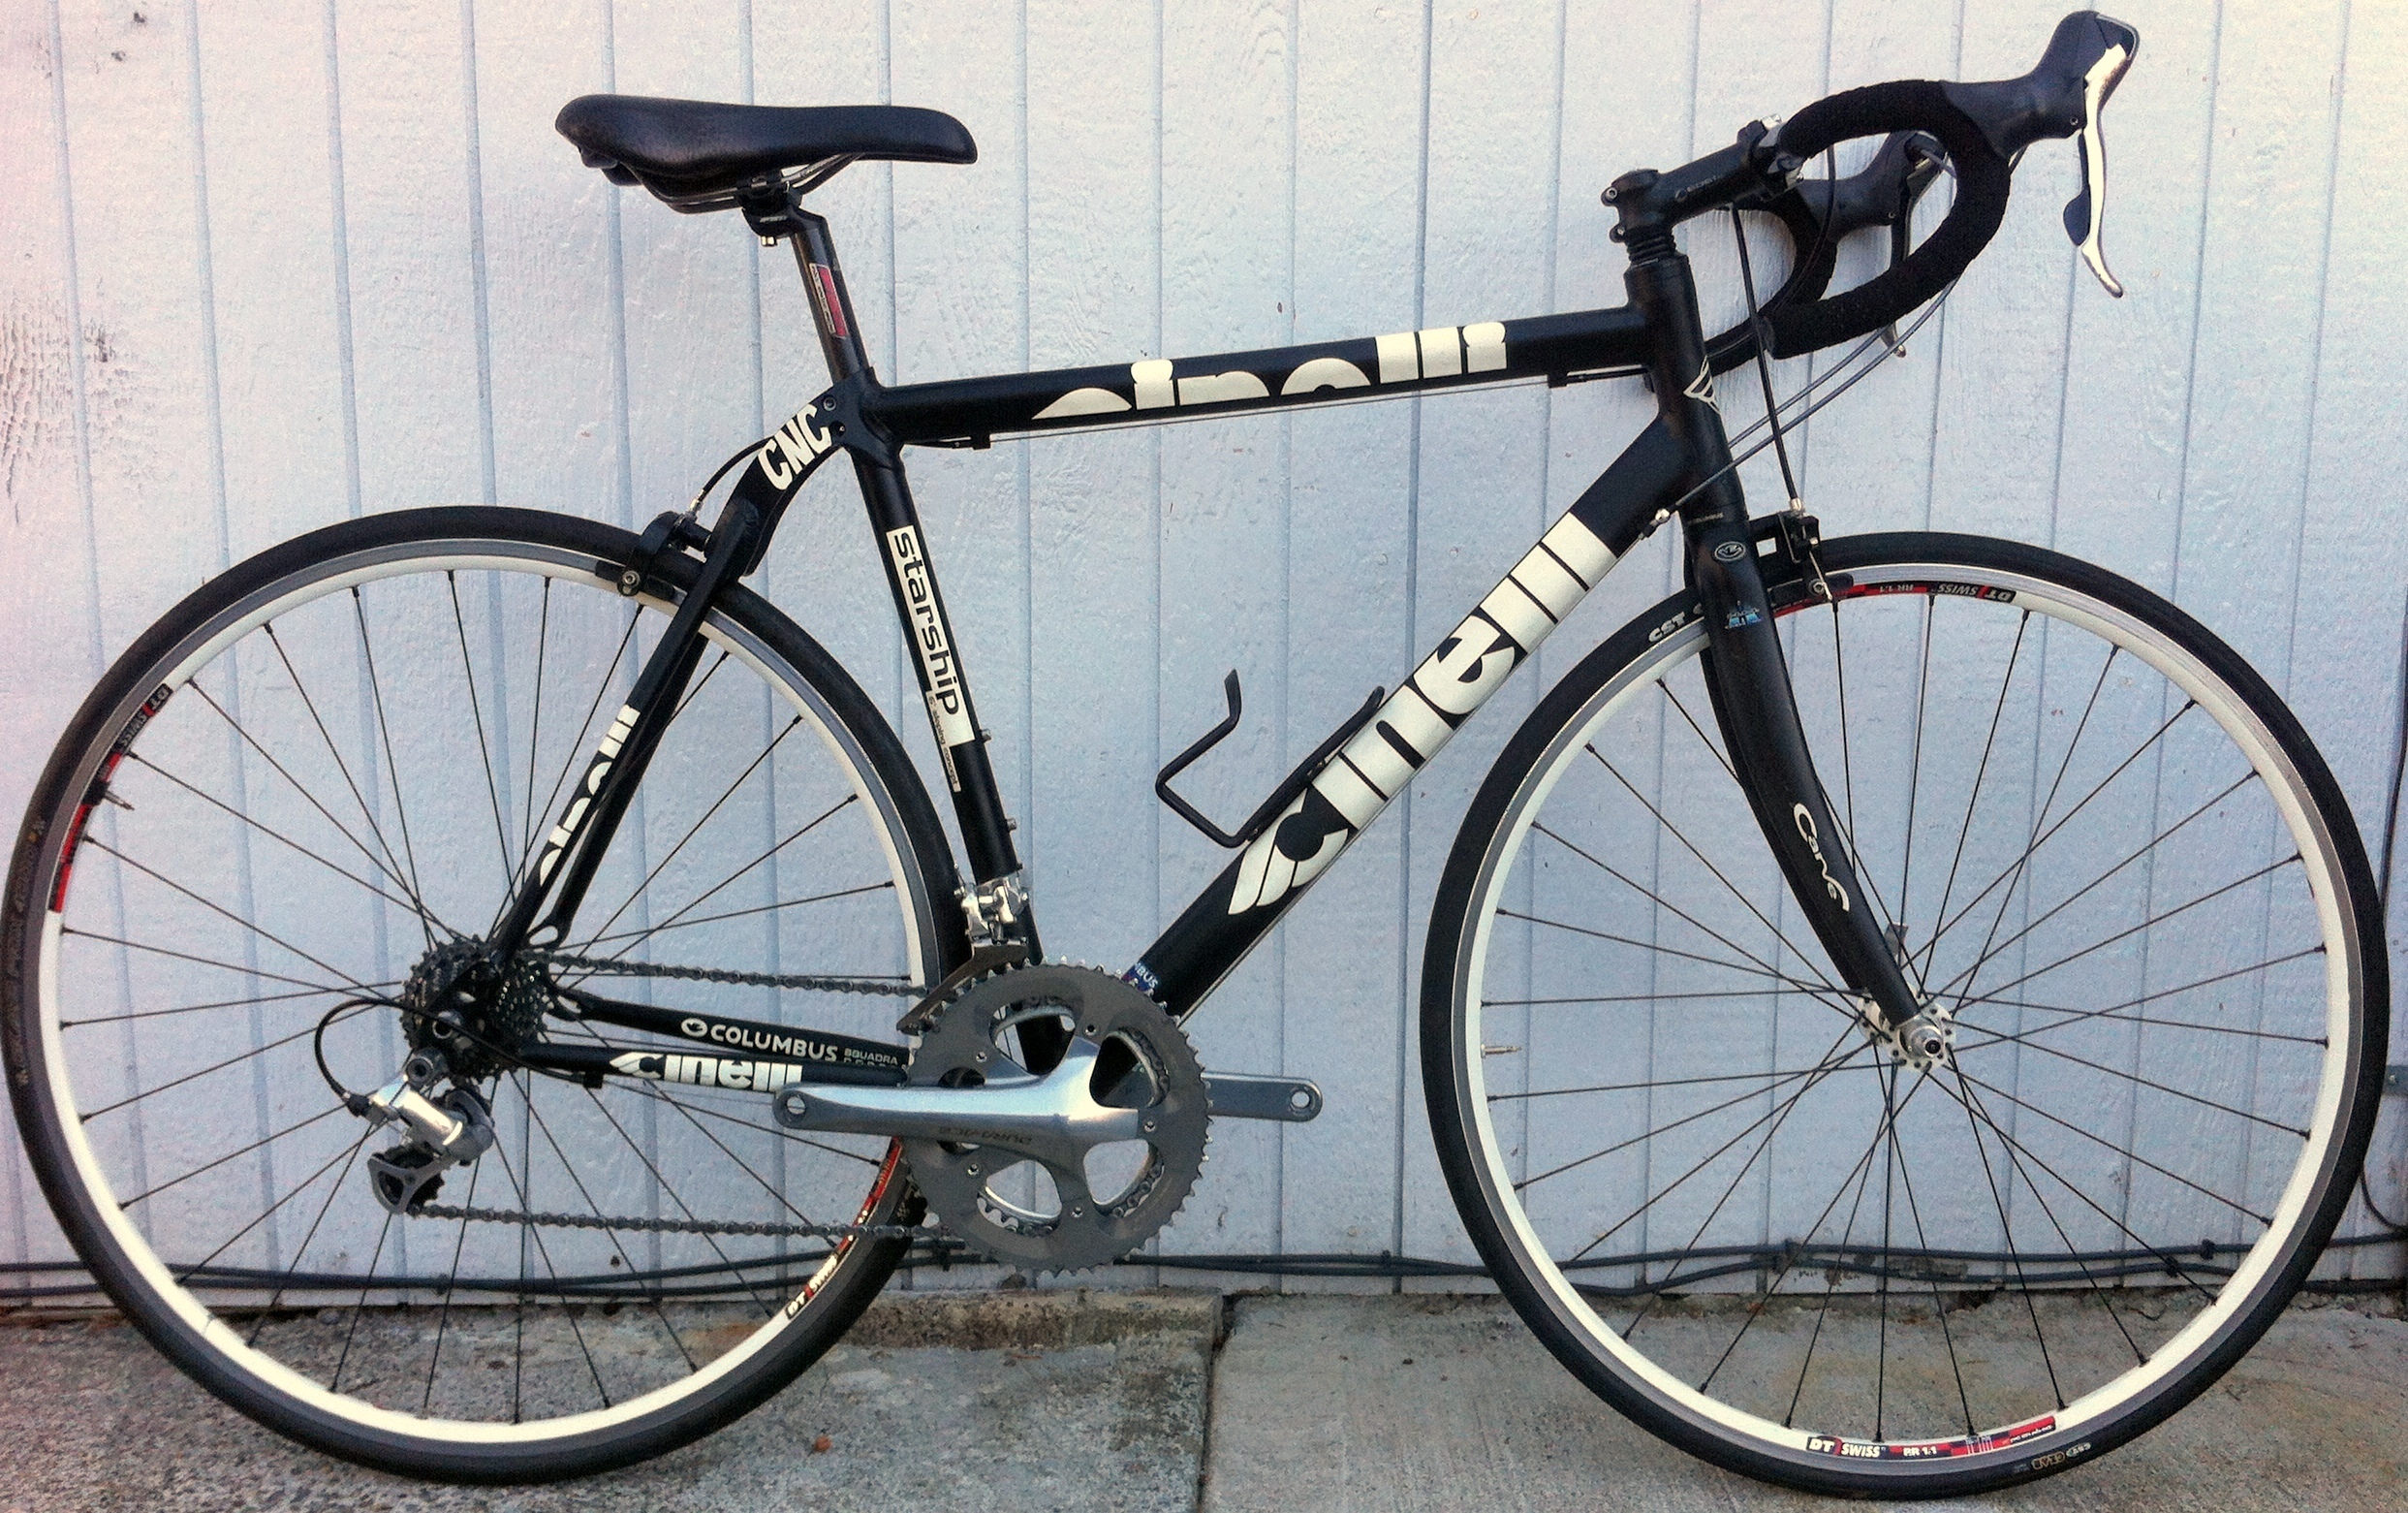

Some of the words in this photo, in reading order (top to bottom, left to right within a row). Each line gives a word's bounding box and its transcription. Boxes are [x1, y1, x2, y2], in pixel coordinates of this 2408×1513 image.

[758, 404, 831, 490] CNC
[1937, 583, 1979, 597] SWISS
[1986, 587, 2011, 603] DT
[894, 532, 959, 715] starship
[1648, 611, 1685, 643] CST
[710, 1024, 838, 1063] COLUMBUS
[1808, 1438, 1835, 1453] DT
[1840, 1445, 1881, 1459] SWISS
